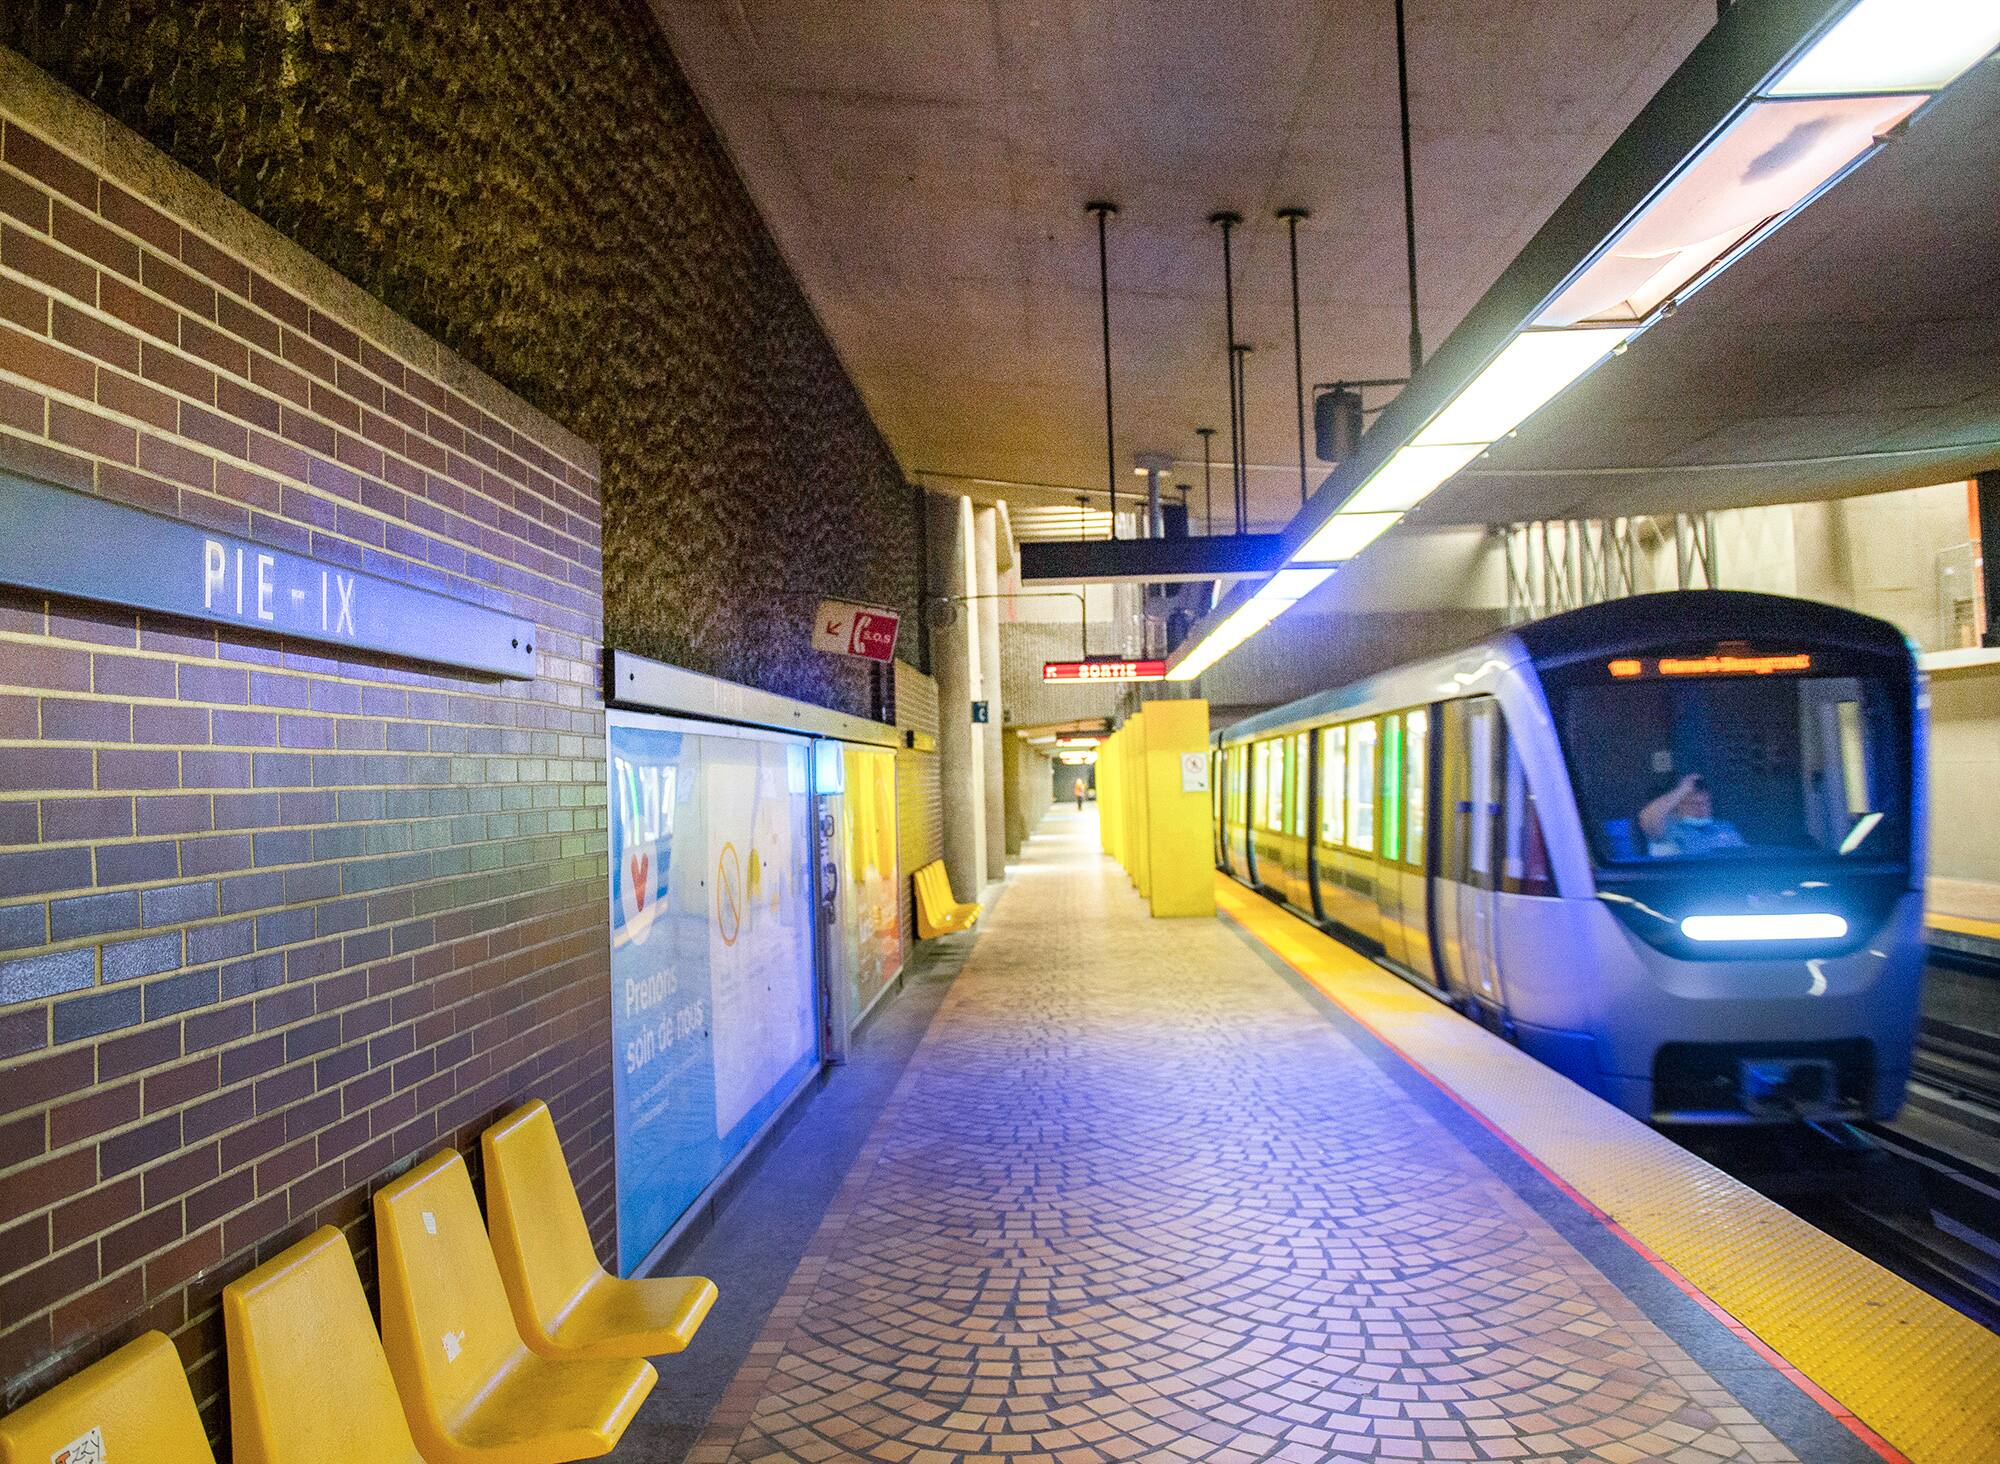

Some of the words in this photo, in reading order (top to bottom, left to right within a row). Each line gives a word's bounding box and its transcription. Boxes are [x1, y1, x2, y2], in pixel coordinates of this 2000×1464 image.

[1078, 663, 1137, 678] SORTIE
[625, 967, 678, 1019] Prenons
[626, 1023, 655, 1074] soin
[658, 1012, 674, 1052] de
[676, 1000, 704, 1041] nous
